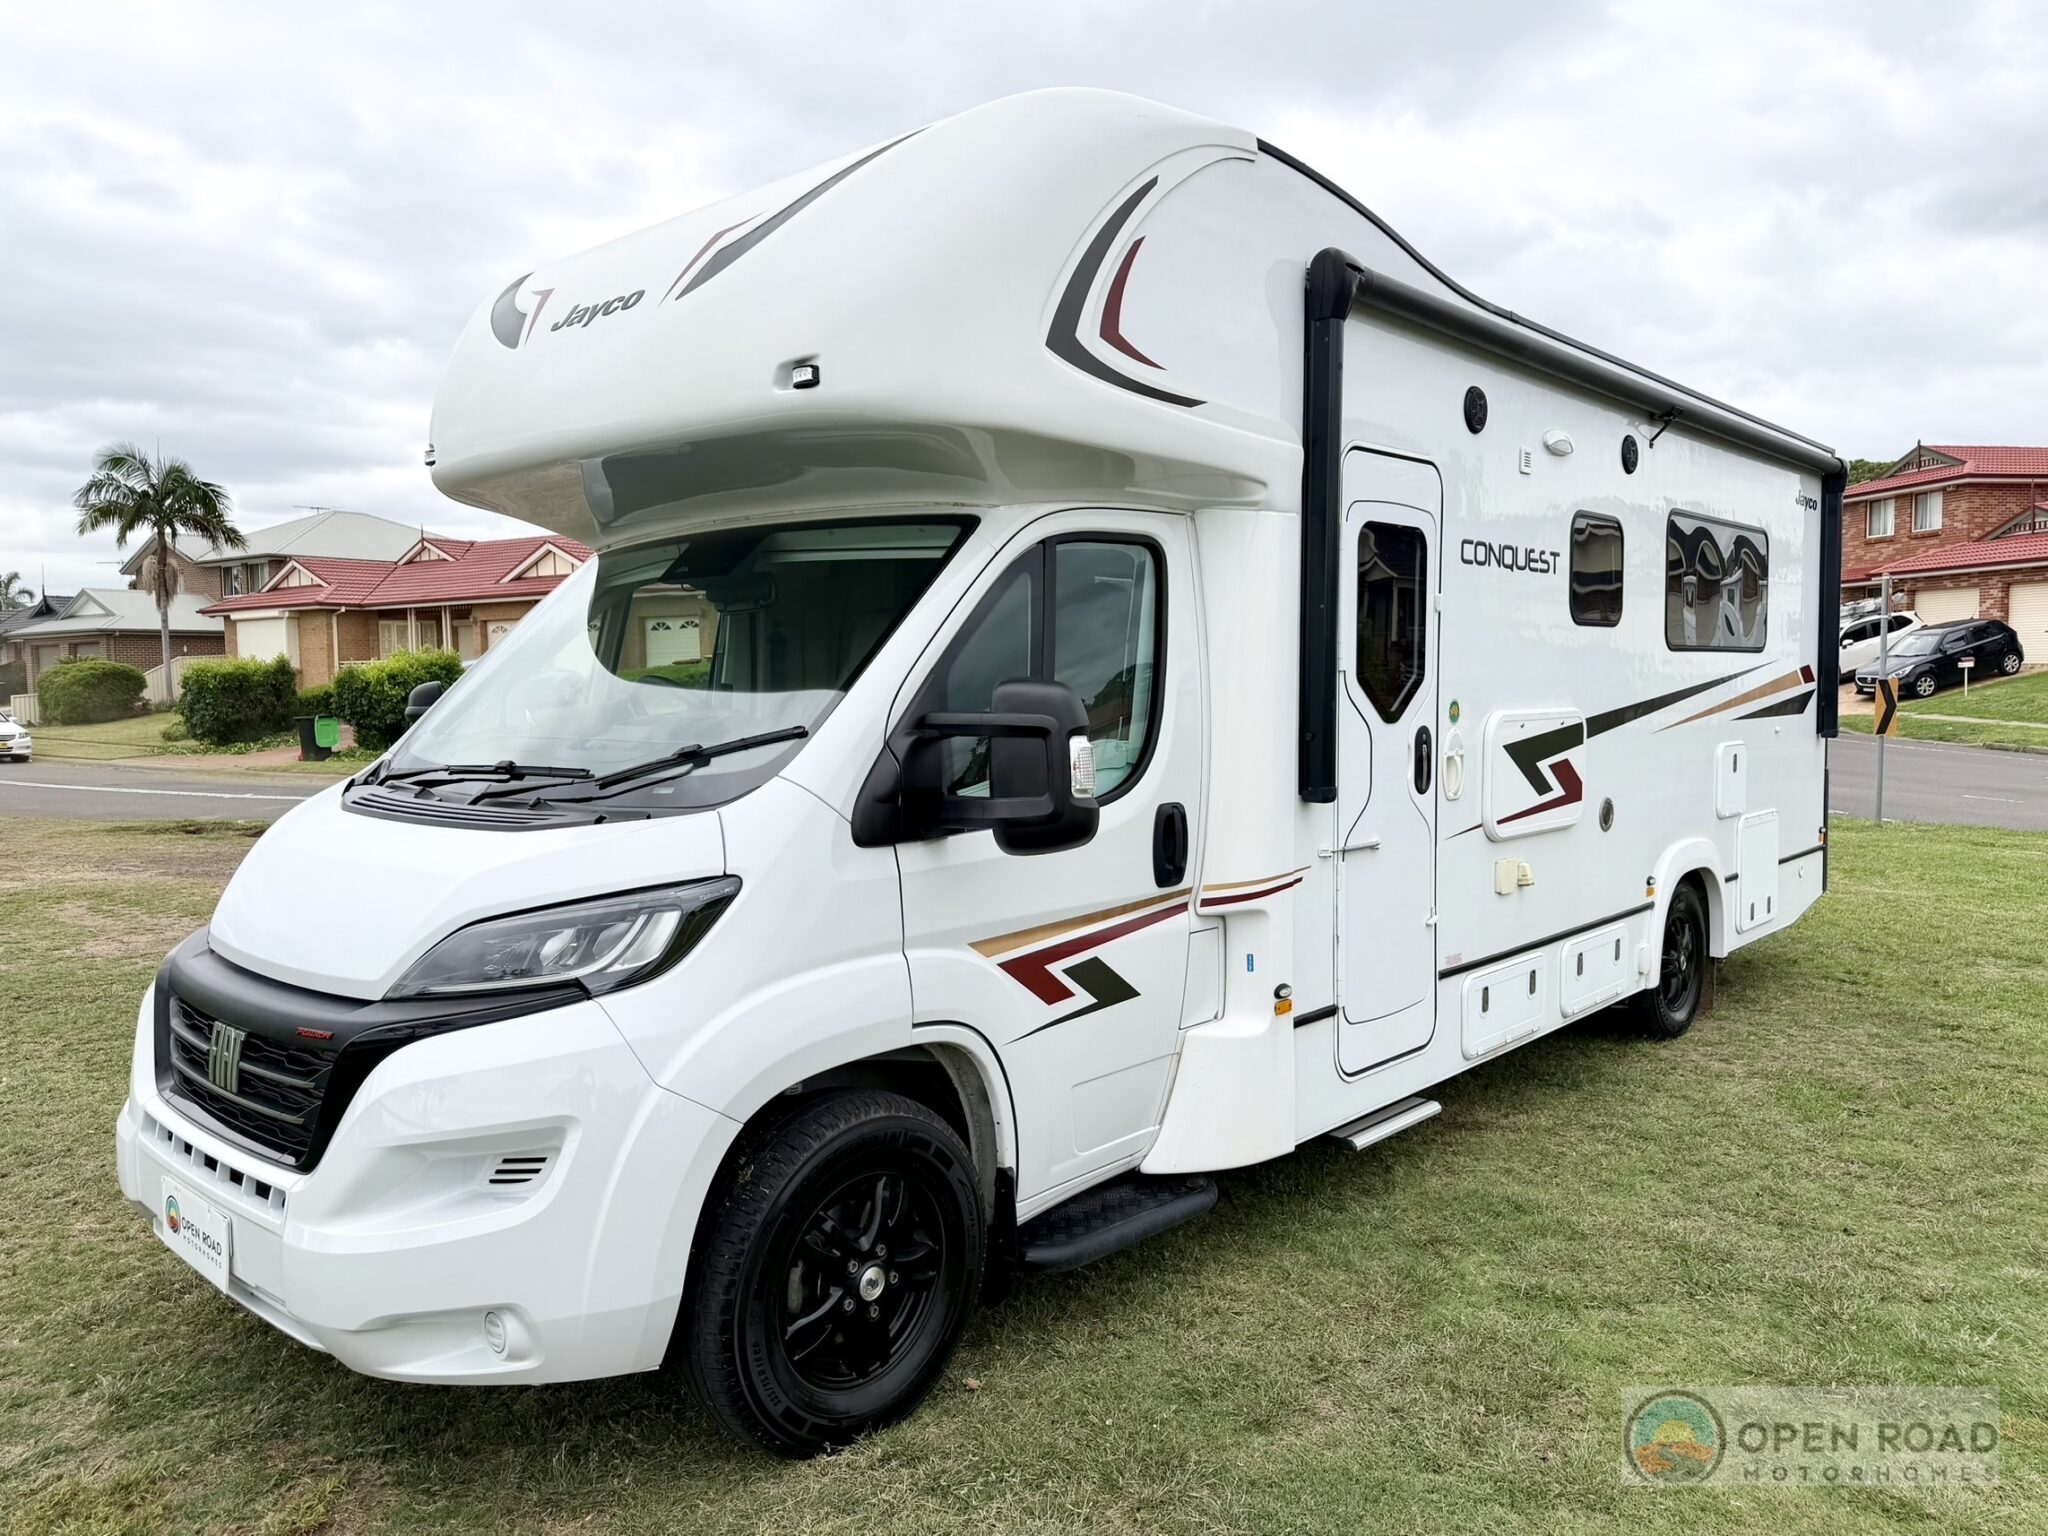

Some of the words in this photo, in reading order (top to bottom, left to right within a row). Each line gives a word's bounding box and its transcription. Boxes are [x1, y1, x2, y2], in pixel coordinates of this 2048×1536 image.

[550, 289, 646, 332] Jayco
[1795, 489, 1818, 512] Jayco
[1460, 538, 1561, 575] CONQUEST
[208, 1020, 247, 1095] FIAT
[181, 1216, 201, 1241] OPEN
[202, 1231, 222, 1256] ROAD
[183, 1235, 222, 1269] MOTORHOMES
